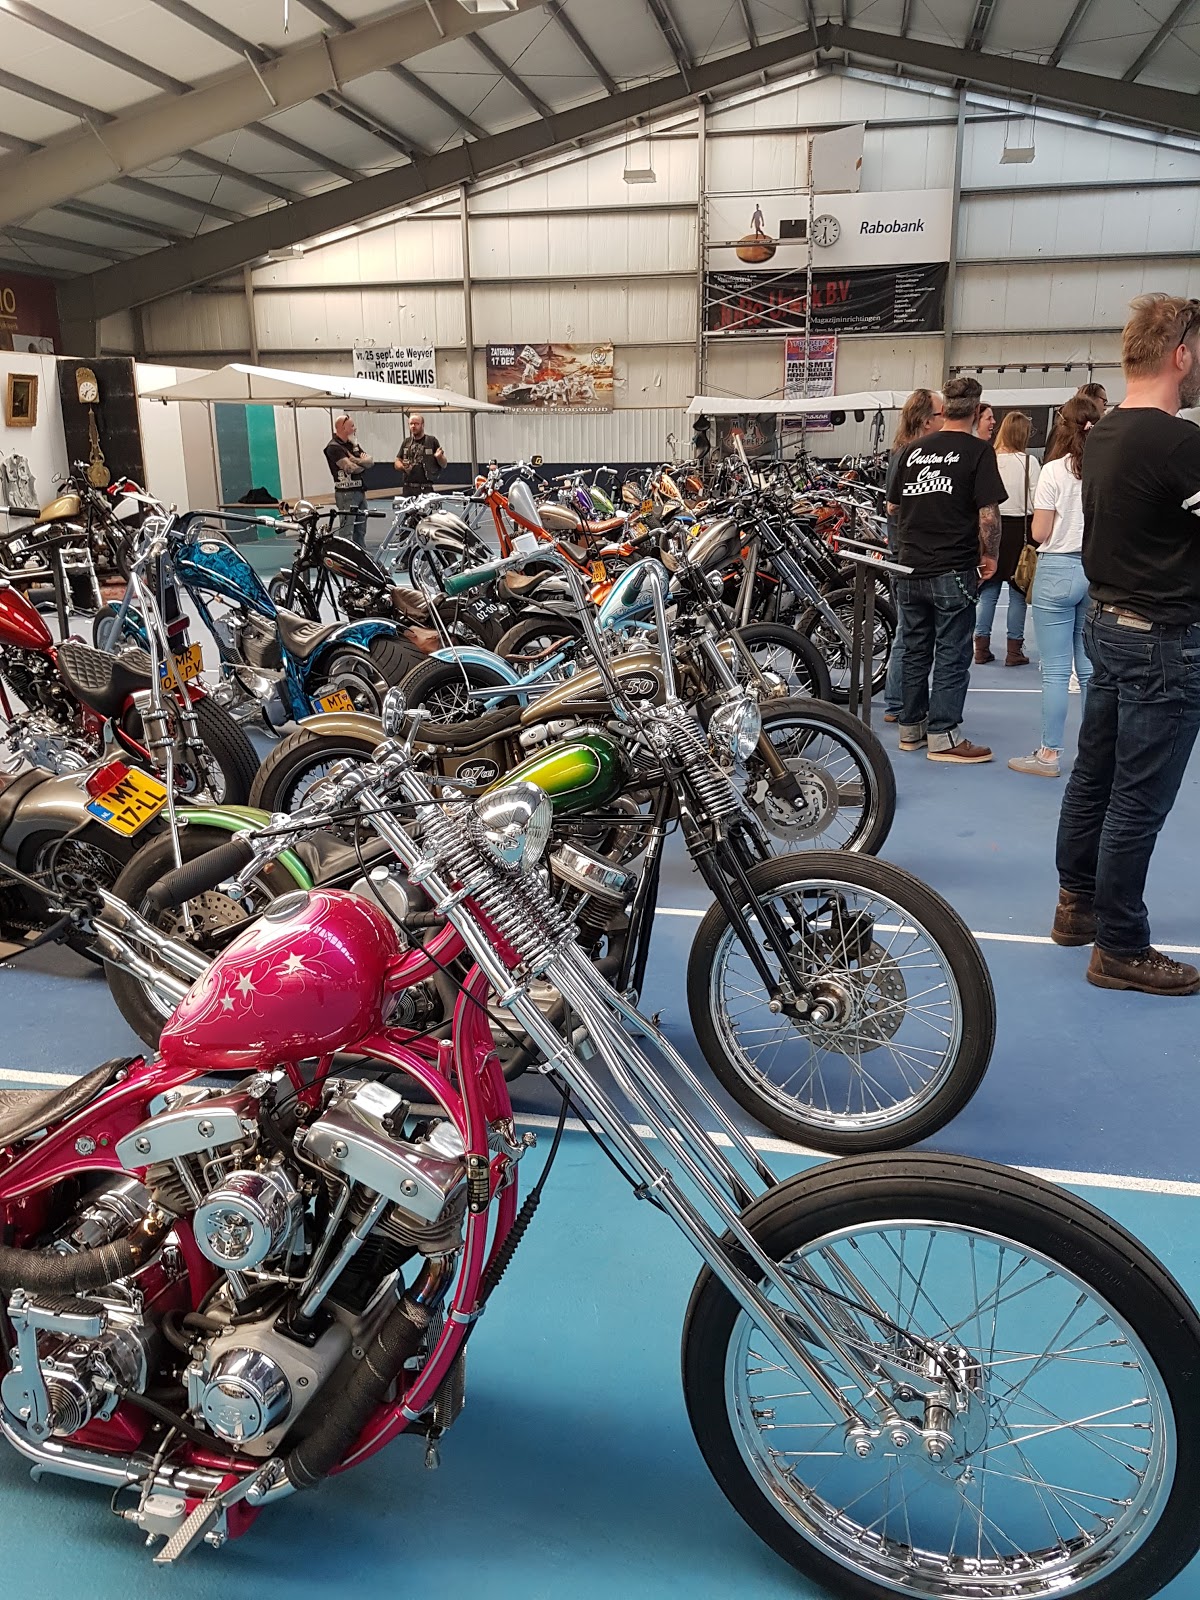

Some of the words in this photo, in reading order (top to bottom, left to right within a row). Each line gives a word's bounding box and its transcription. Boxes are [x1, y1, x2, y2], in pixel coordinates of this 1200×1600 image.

[859, 218, 925, 235] Rabobank
[810, 315, 881, 324] Magazijninrichtingen
[365, 350, 374, 360] 25
[375, 349, 394, 361] sept.
[395, 348, 404, 358] de
[406, 347, 433, 360] Weyver
[490, 347, 515, 356] ZATERDAG
[375, 360, 413, 369] Hoogwoud
[491, 357, 501, 366] 17
[501, 356, 515, 366] DEC
[808, 361, 833, 369] SMIT
[387, 369, 435, 385] MEEUWIS
[906, 447, 943, 468] Custom
[917, 465, 941, 482] Crew
[472, 599, 487, 611] ZM
[476, 603, 498, 620] 02-00
[625, 679, 655, 695] 50
[326, 693, 343, 709] MT
[116, 789, 167, 827] 17-LL
